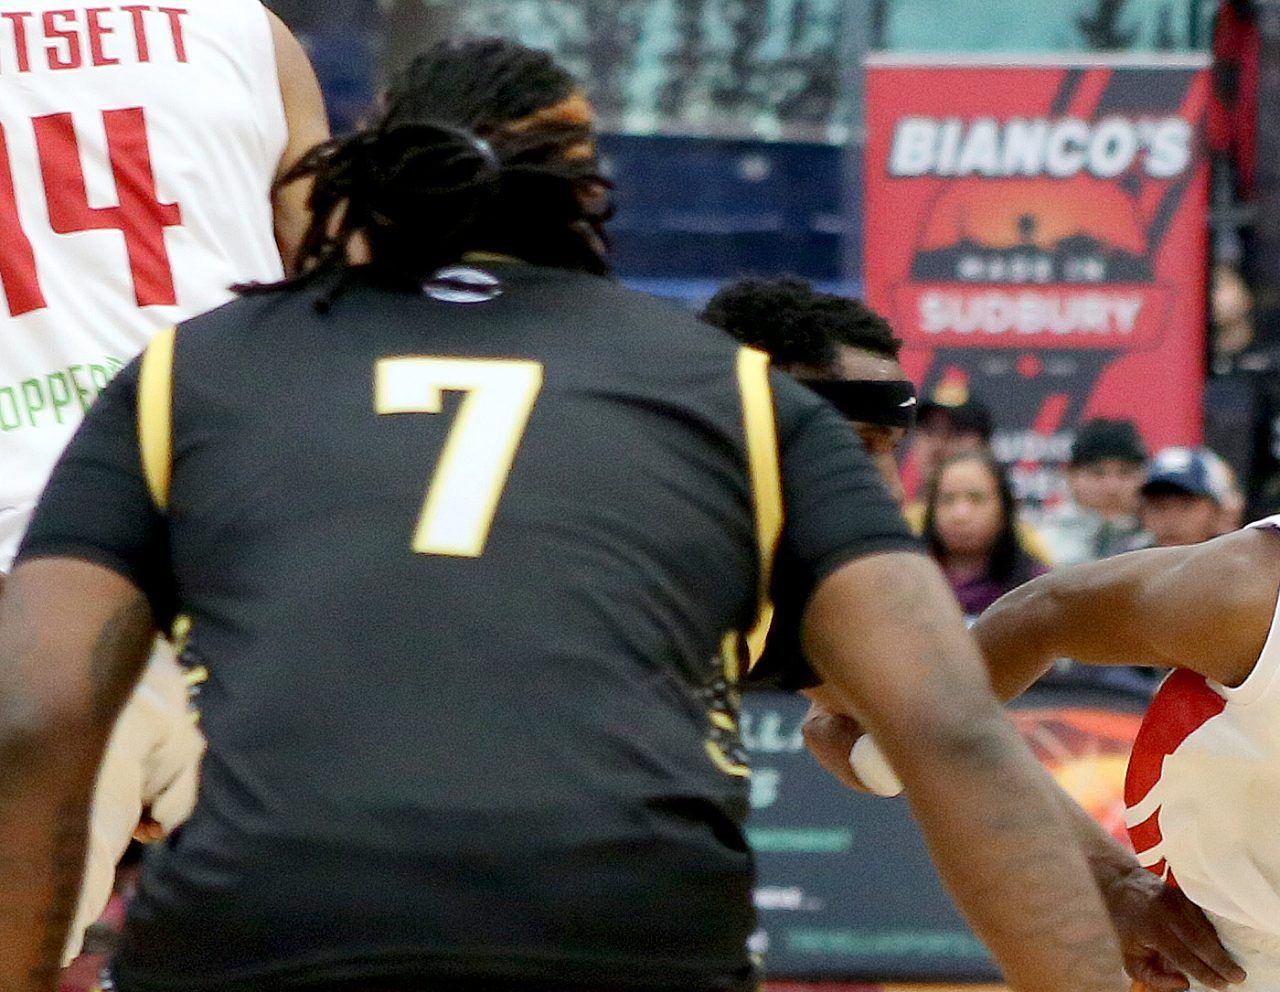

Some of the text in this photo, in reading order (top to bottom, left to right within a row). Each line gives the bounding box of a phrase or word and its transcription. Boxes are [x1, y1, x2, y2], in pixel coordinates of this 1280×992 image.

[889, 116, 1193, 179] BIANCO'S
[917, 293, 1144, 335] SUDBURY
[374, 355, 544, 557] 7
